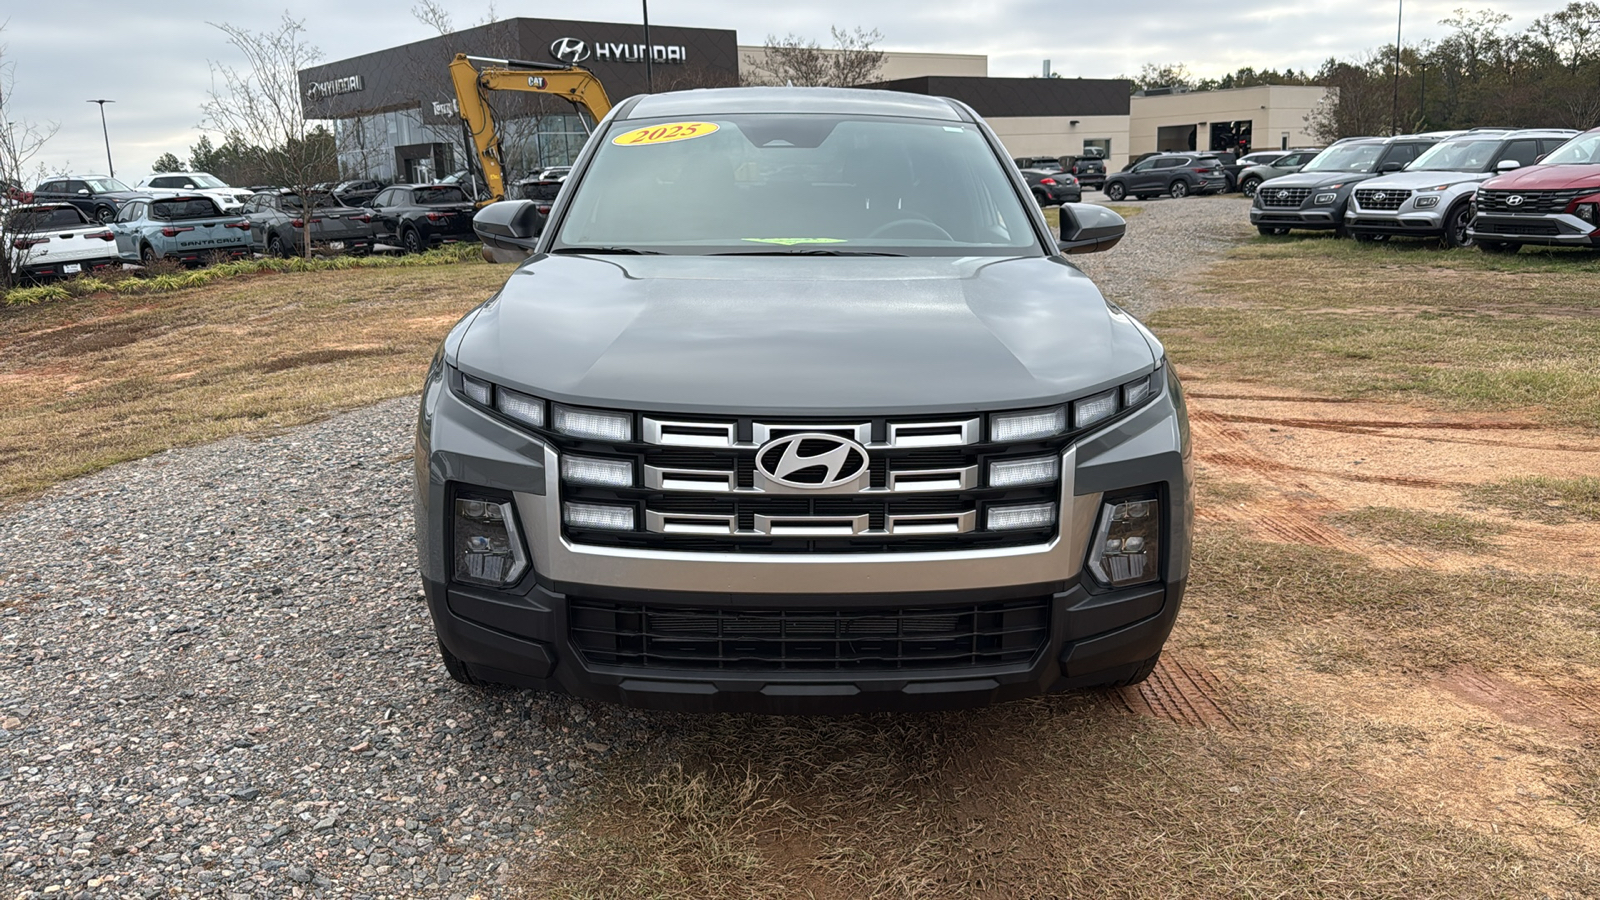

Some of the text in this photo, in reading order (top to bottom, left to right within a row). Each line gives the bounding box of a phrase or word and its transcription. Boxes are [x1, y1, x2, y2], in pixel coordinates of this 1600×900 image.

[596, 42, 686, 61] HYUNDAI
[528, 76, 543, 87] CAT
[629, 123, 702, 144] 2025
